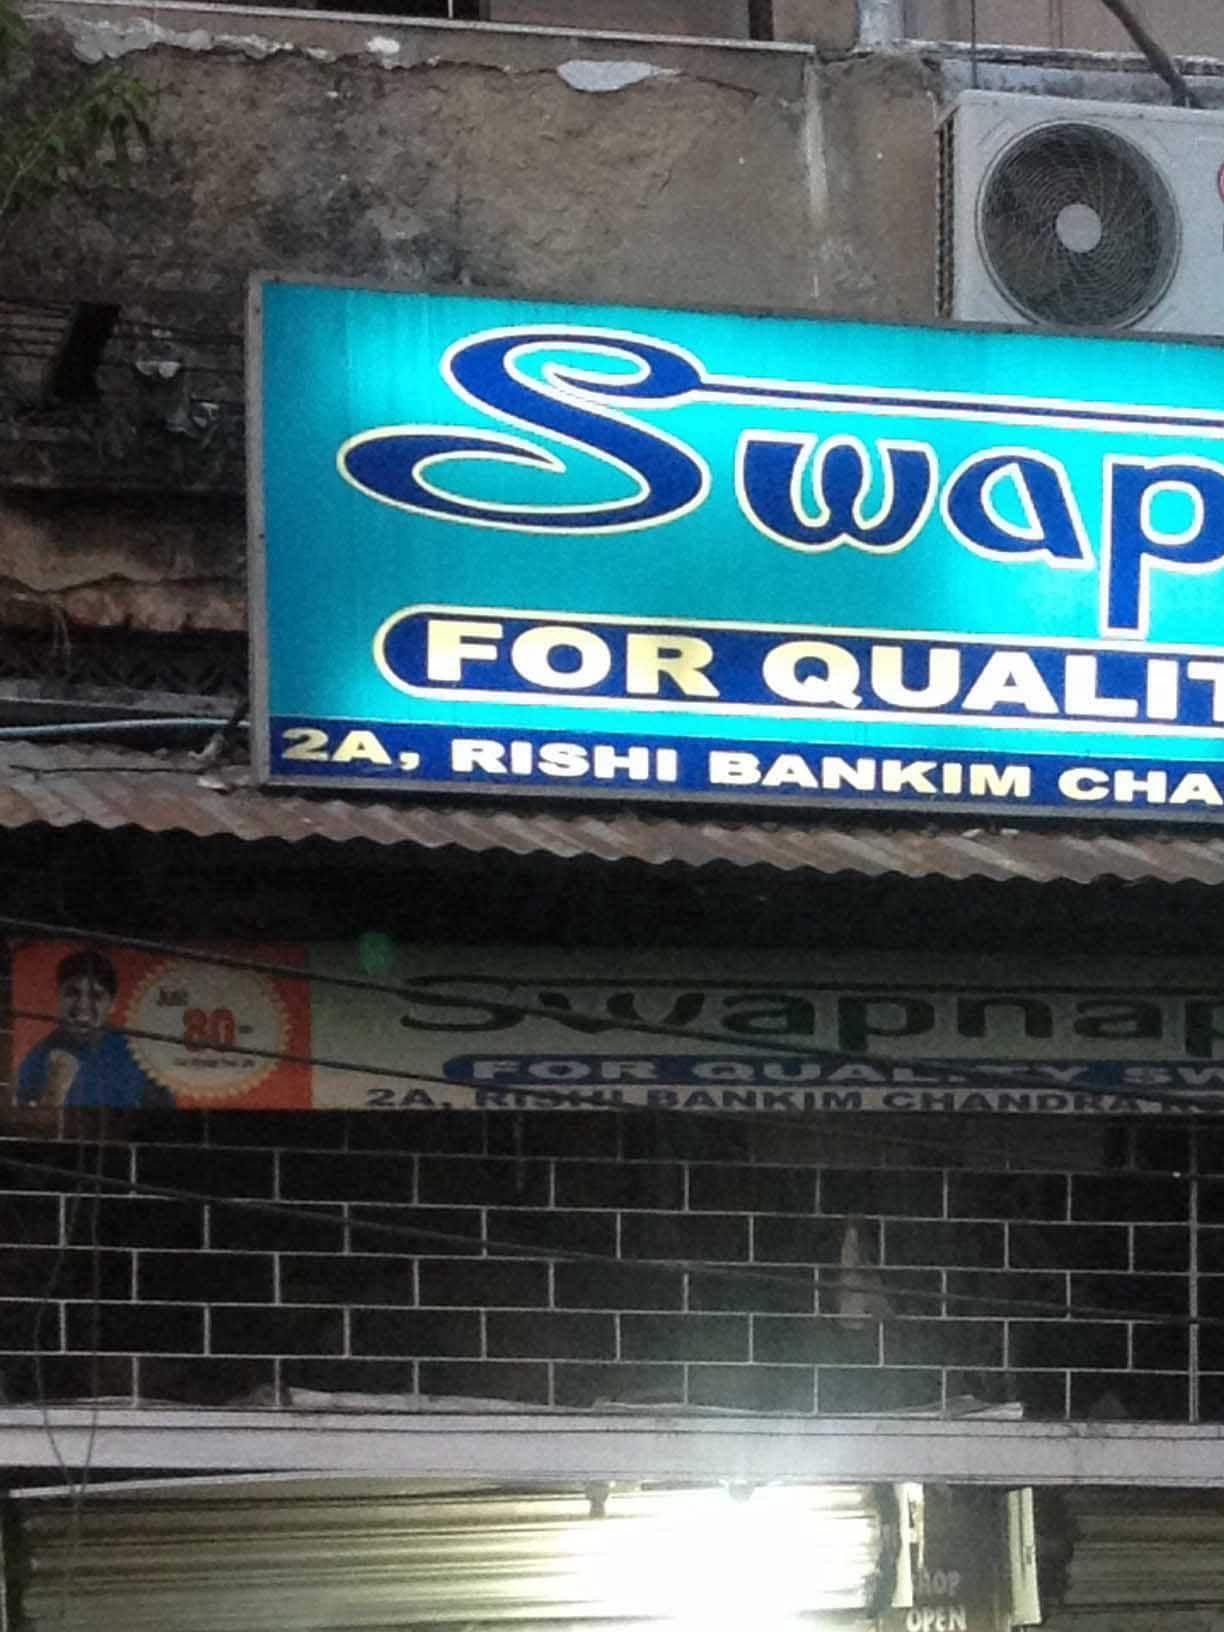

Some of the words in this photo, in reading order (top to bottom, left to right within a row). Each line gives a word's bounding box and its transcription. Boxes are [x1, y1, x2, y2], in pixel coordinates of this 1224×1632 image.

[425, 619, 716, 697] FOR
[281, 728, 420, 770] 2A,
[451, 738, 678, 783] RISHI
[708, 751, 1031, 798] BANKIM
[472, 1060, 660, 1081] FOR
[691, 1061, 1089, 1084] QUALY
[906, 1606, 967, 1632] OPEN
